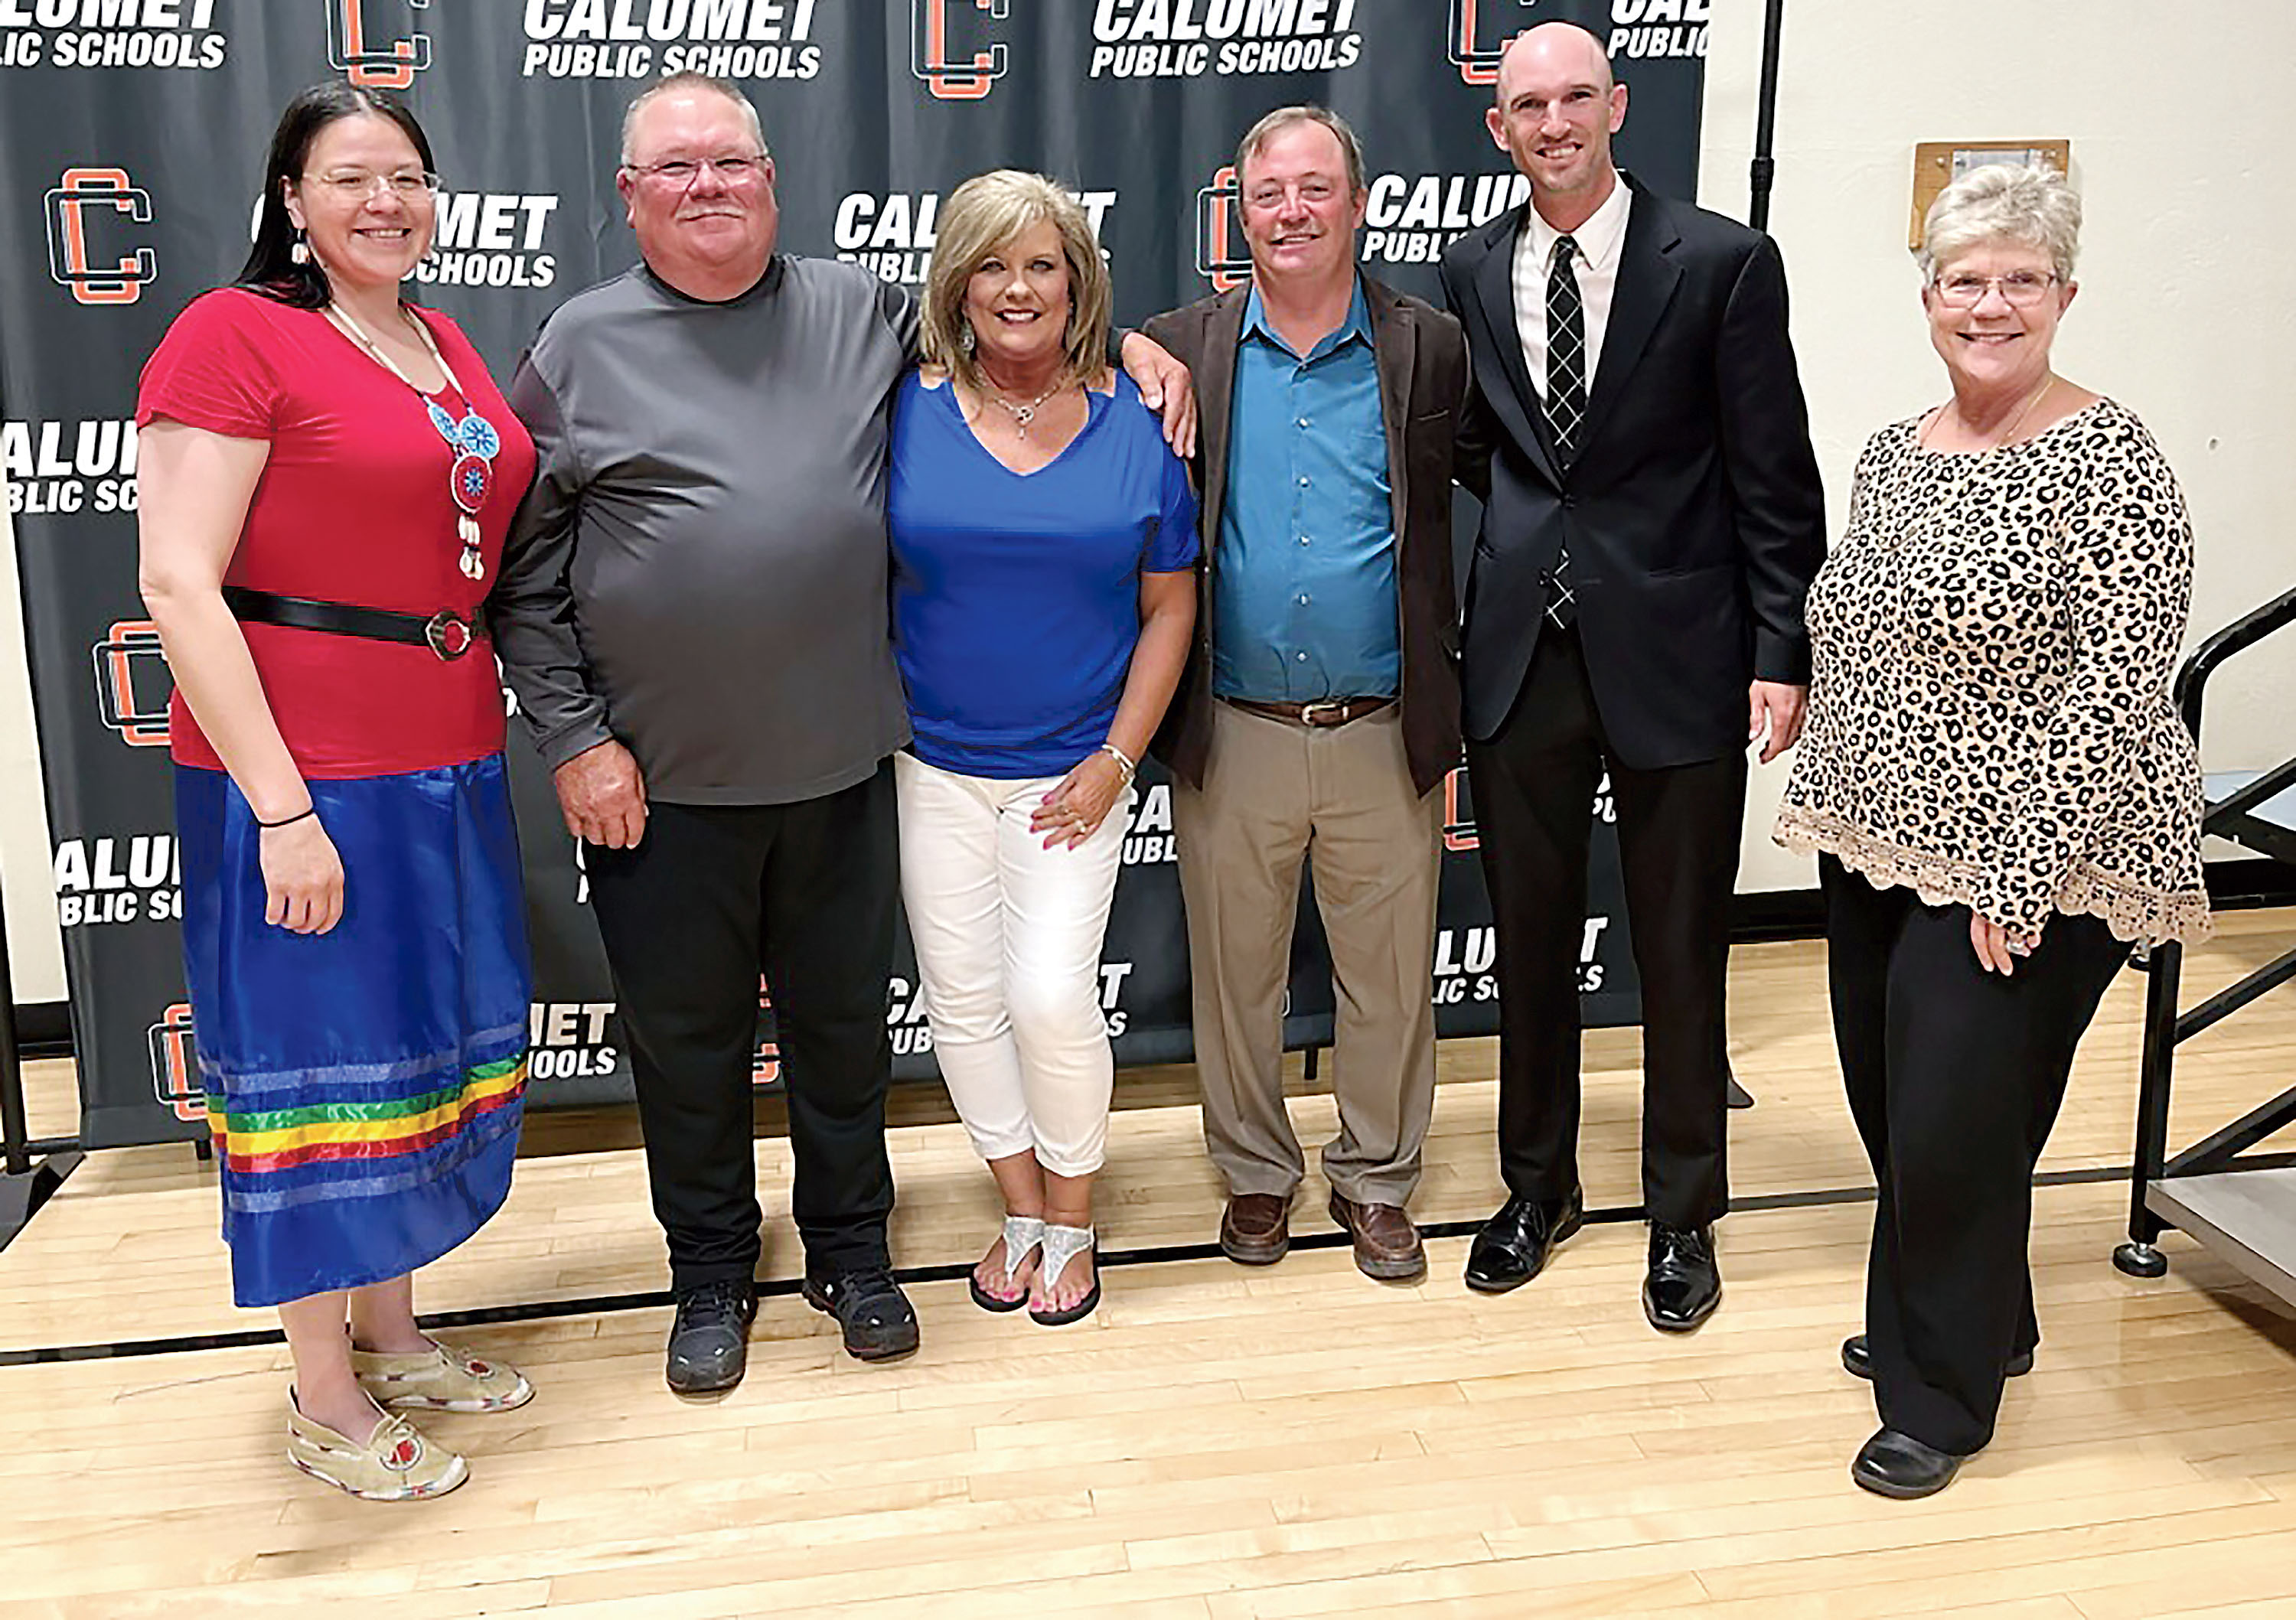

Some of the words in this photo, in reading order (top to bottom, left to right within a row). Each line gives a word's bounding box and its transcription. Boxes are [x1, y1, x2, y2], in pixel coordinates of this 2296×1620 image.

[523, 0, 816, 41] CALUMET
[1093, 0, 1355, 42] CALUMET
[51, 32, 226, 68] SCHOOLS
[523, 43, 652, 77] PUBLIC
[661, 44, 821, 79] SCHOOLS
[1090, 44, 1209, 77] PUBLIC
[1215, 34, 1362, 75] SCHOOLS
[400, 251, 556, 288] CHOOLS
